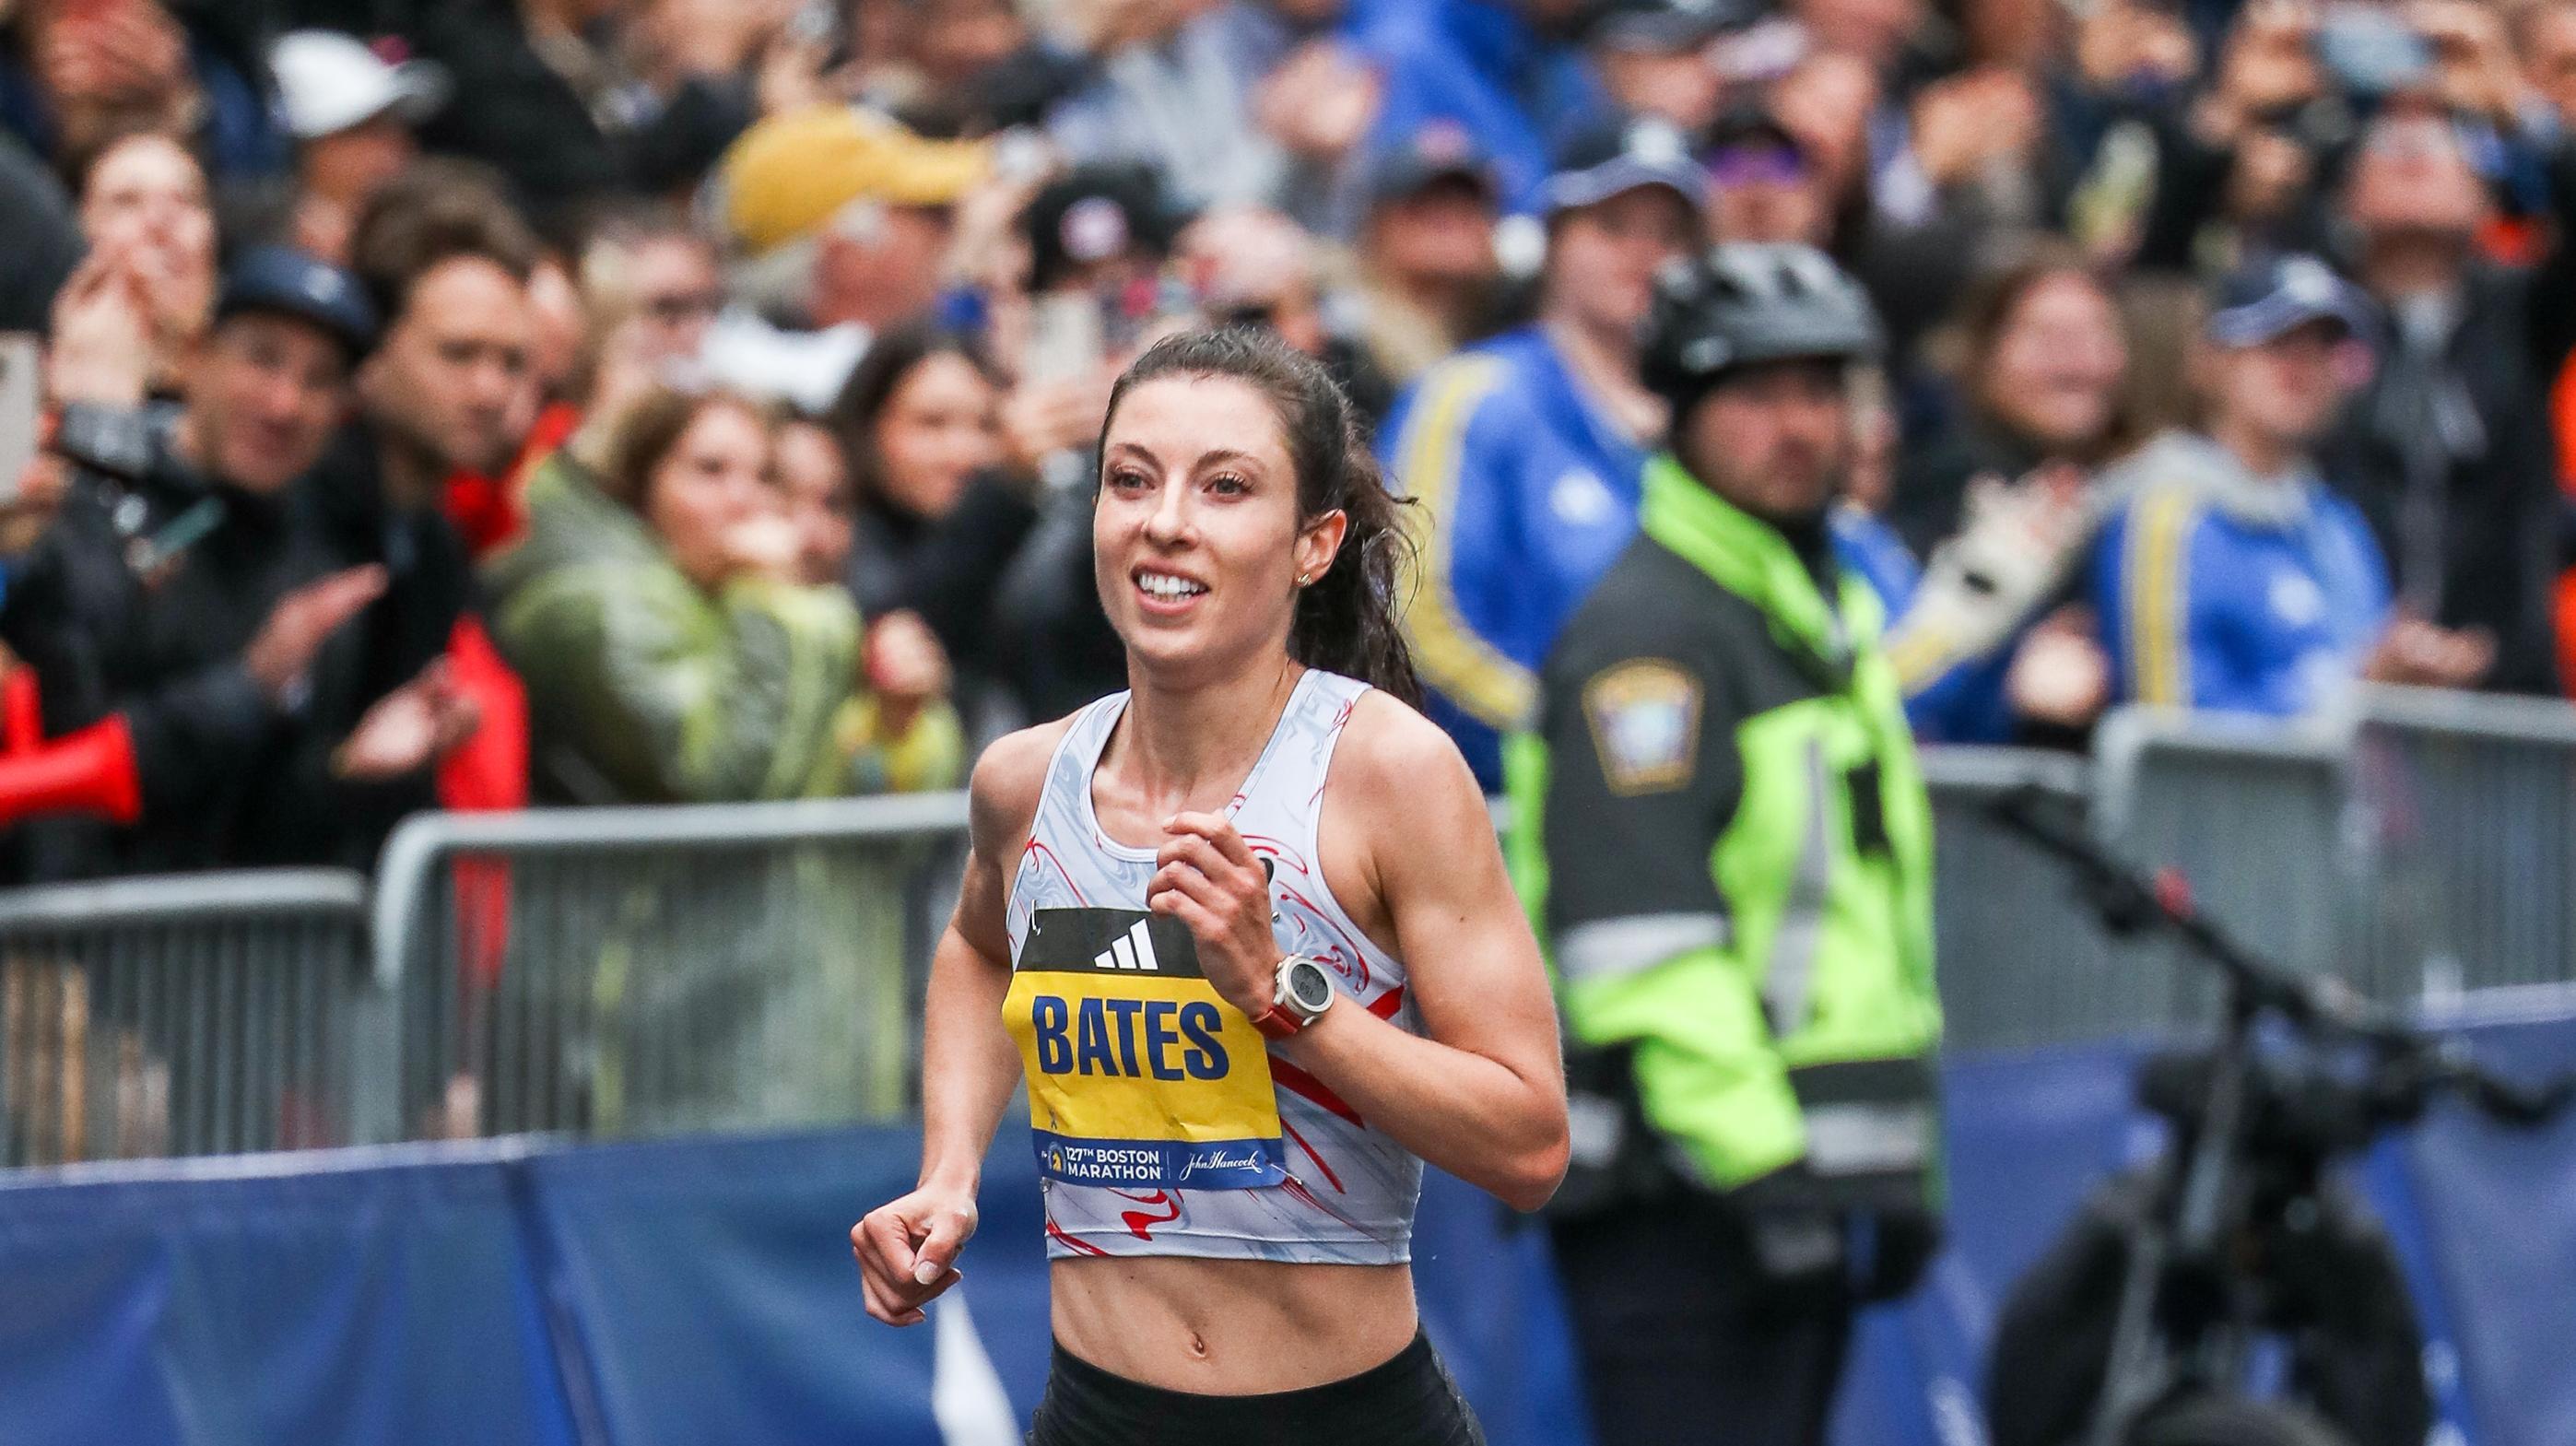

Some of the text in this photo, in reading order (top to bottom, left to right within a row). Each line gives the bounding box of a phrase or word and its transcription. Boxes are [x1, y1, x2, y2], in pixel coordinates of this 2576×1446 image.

[1032, 995, 1229, 1081] BATES
[1065, 1146, 1094, 1161] 127TH
[1097, 1148, 1159, 1165] BOSTON
[1179, 1149, 1264, 1181] John Hancock
[1067, 1162, 1161, 1180] MARATHON
